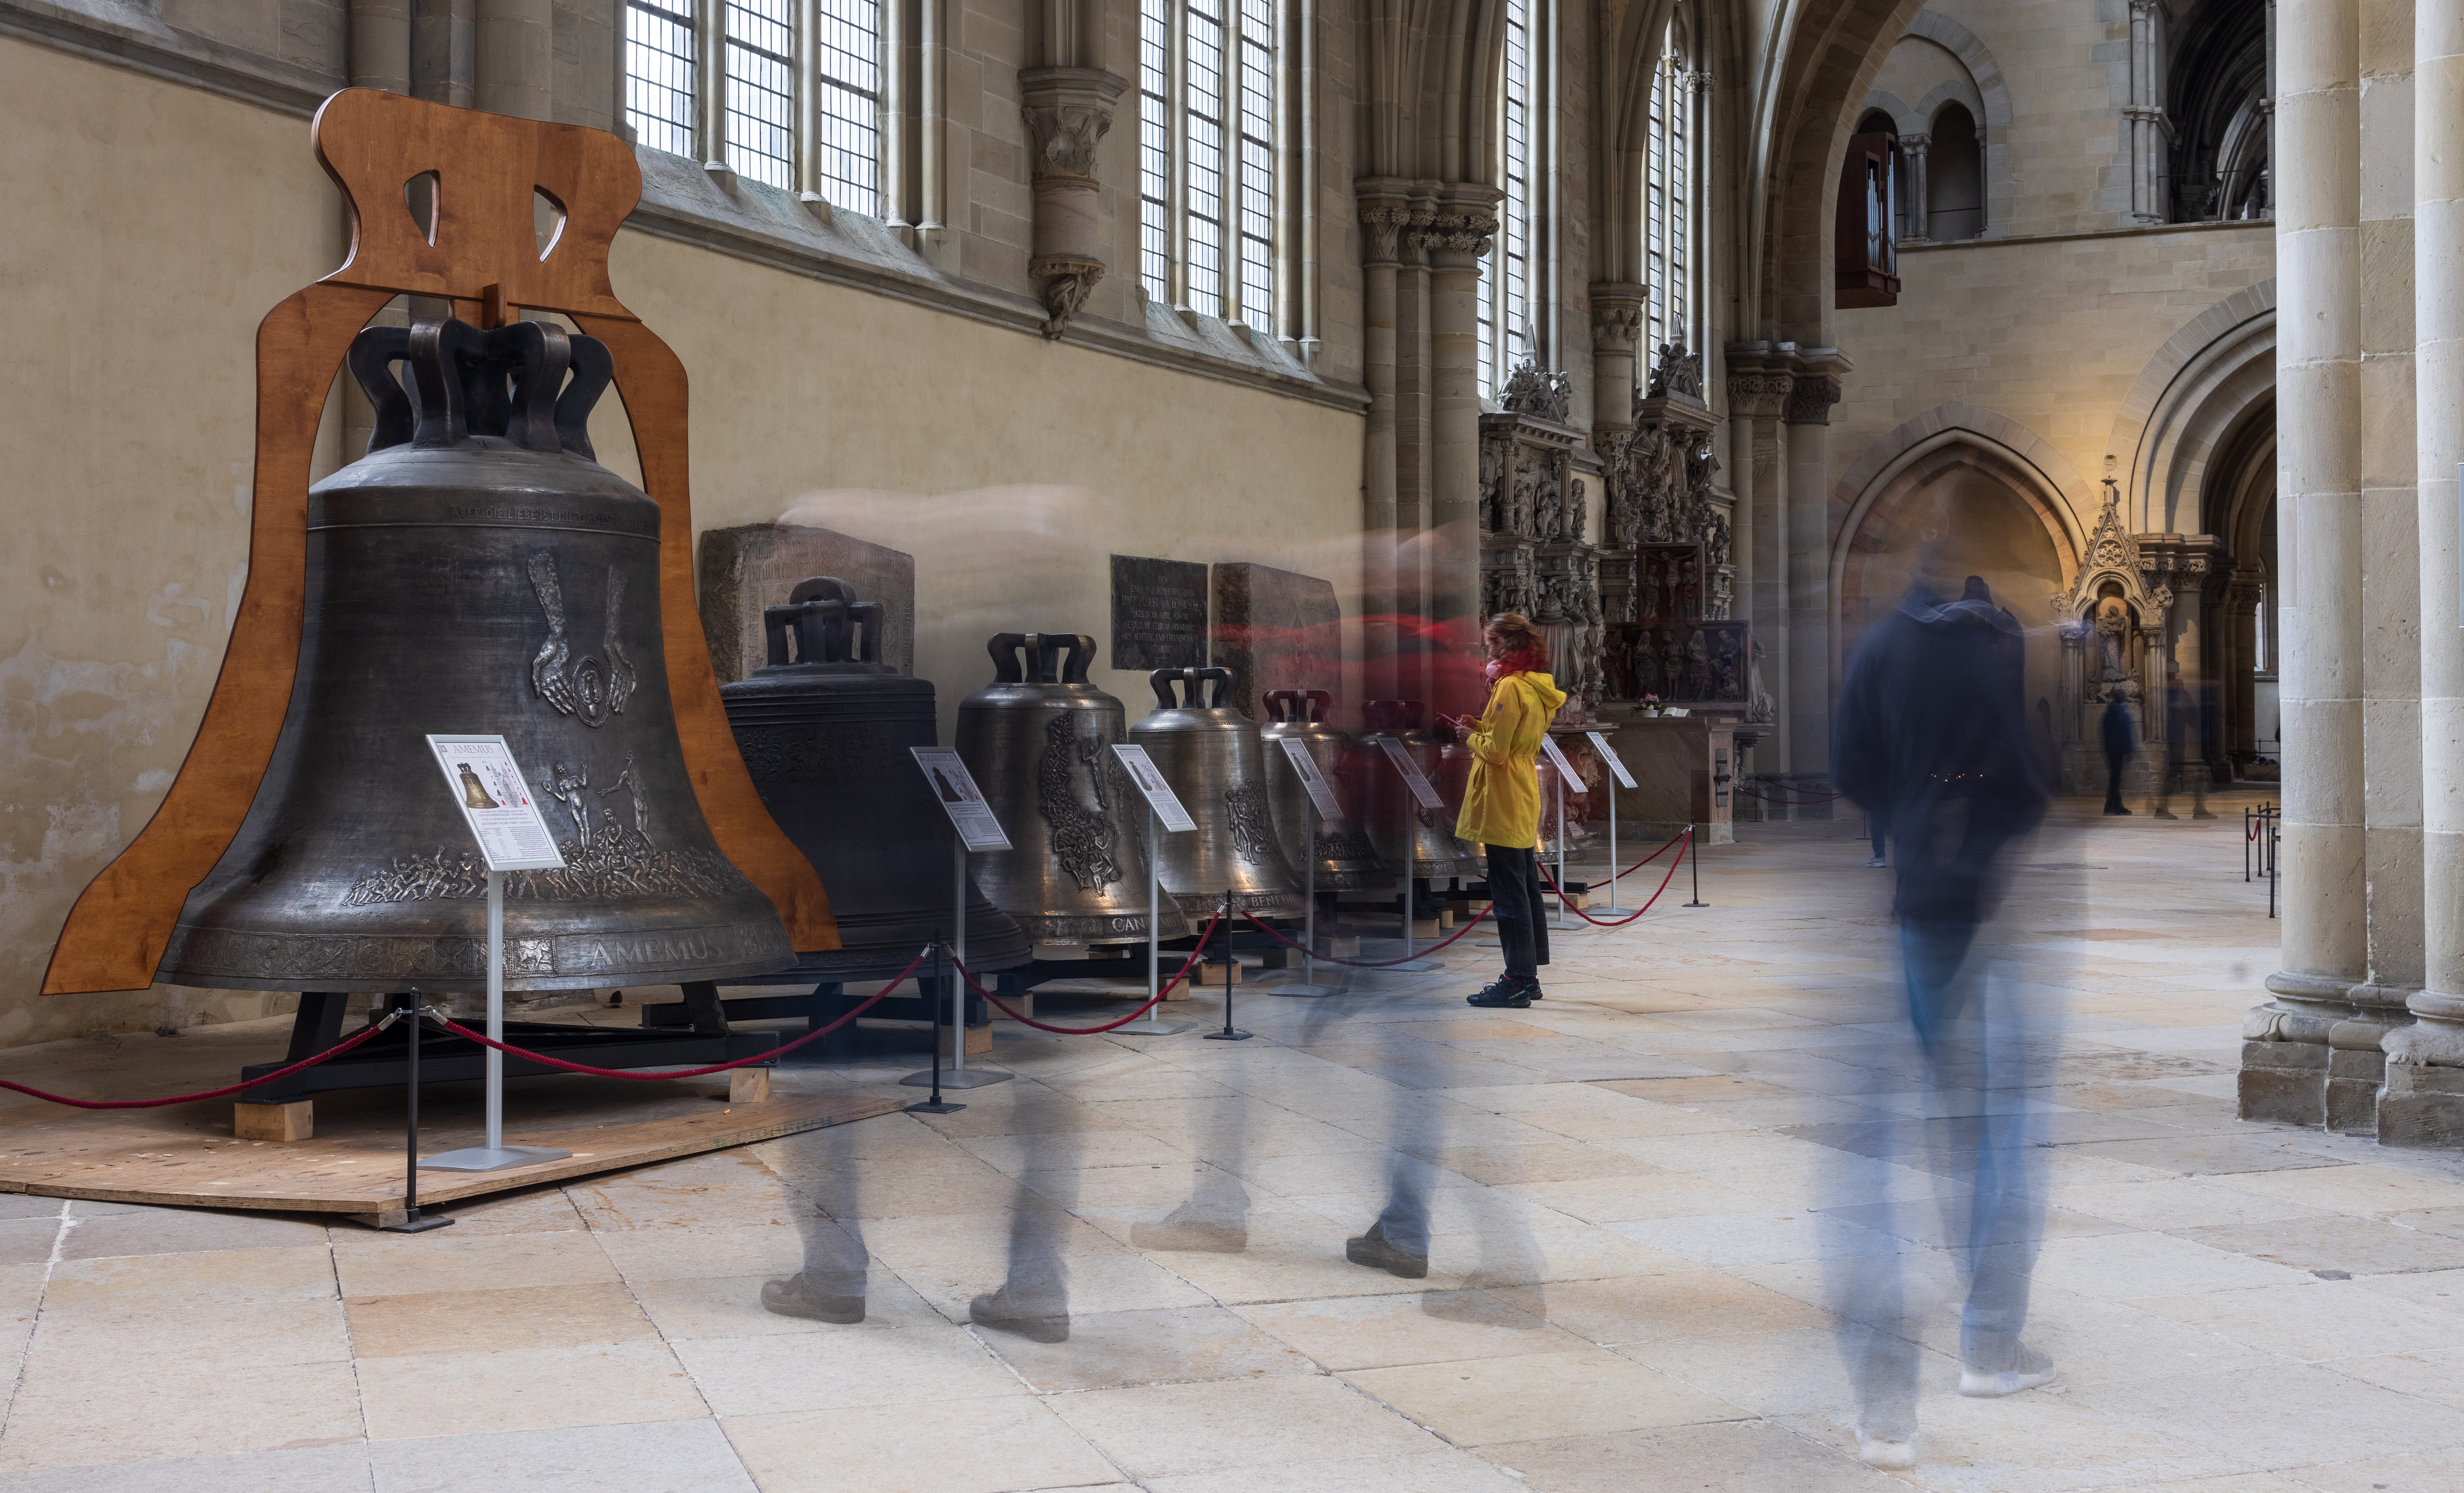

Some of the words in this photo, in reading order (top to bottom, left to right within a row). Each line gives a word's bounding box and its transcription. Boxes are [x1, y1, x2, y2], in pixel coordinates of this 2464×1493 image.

[450, 507, 482, 518] ABER
[486, 508, 503, 519] DIE
[508, 508, 537, 520] LIEBE
[539, 508, 556, 521] IST
[559, 511, 575, 522] DIE
[454, 745, 494, 753] AMEMUS
[590, 934, 722, 967] AMEMUS
